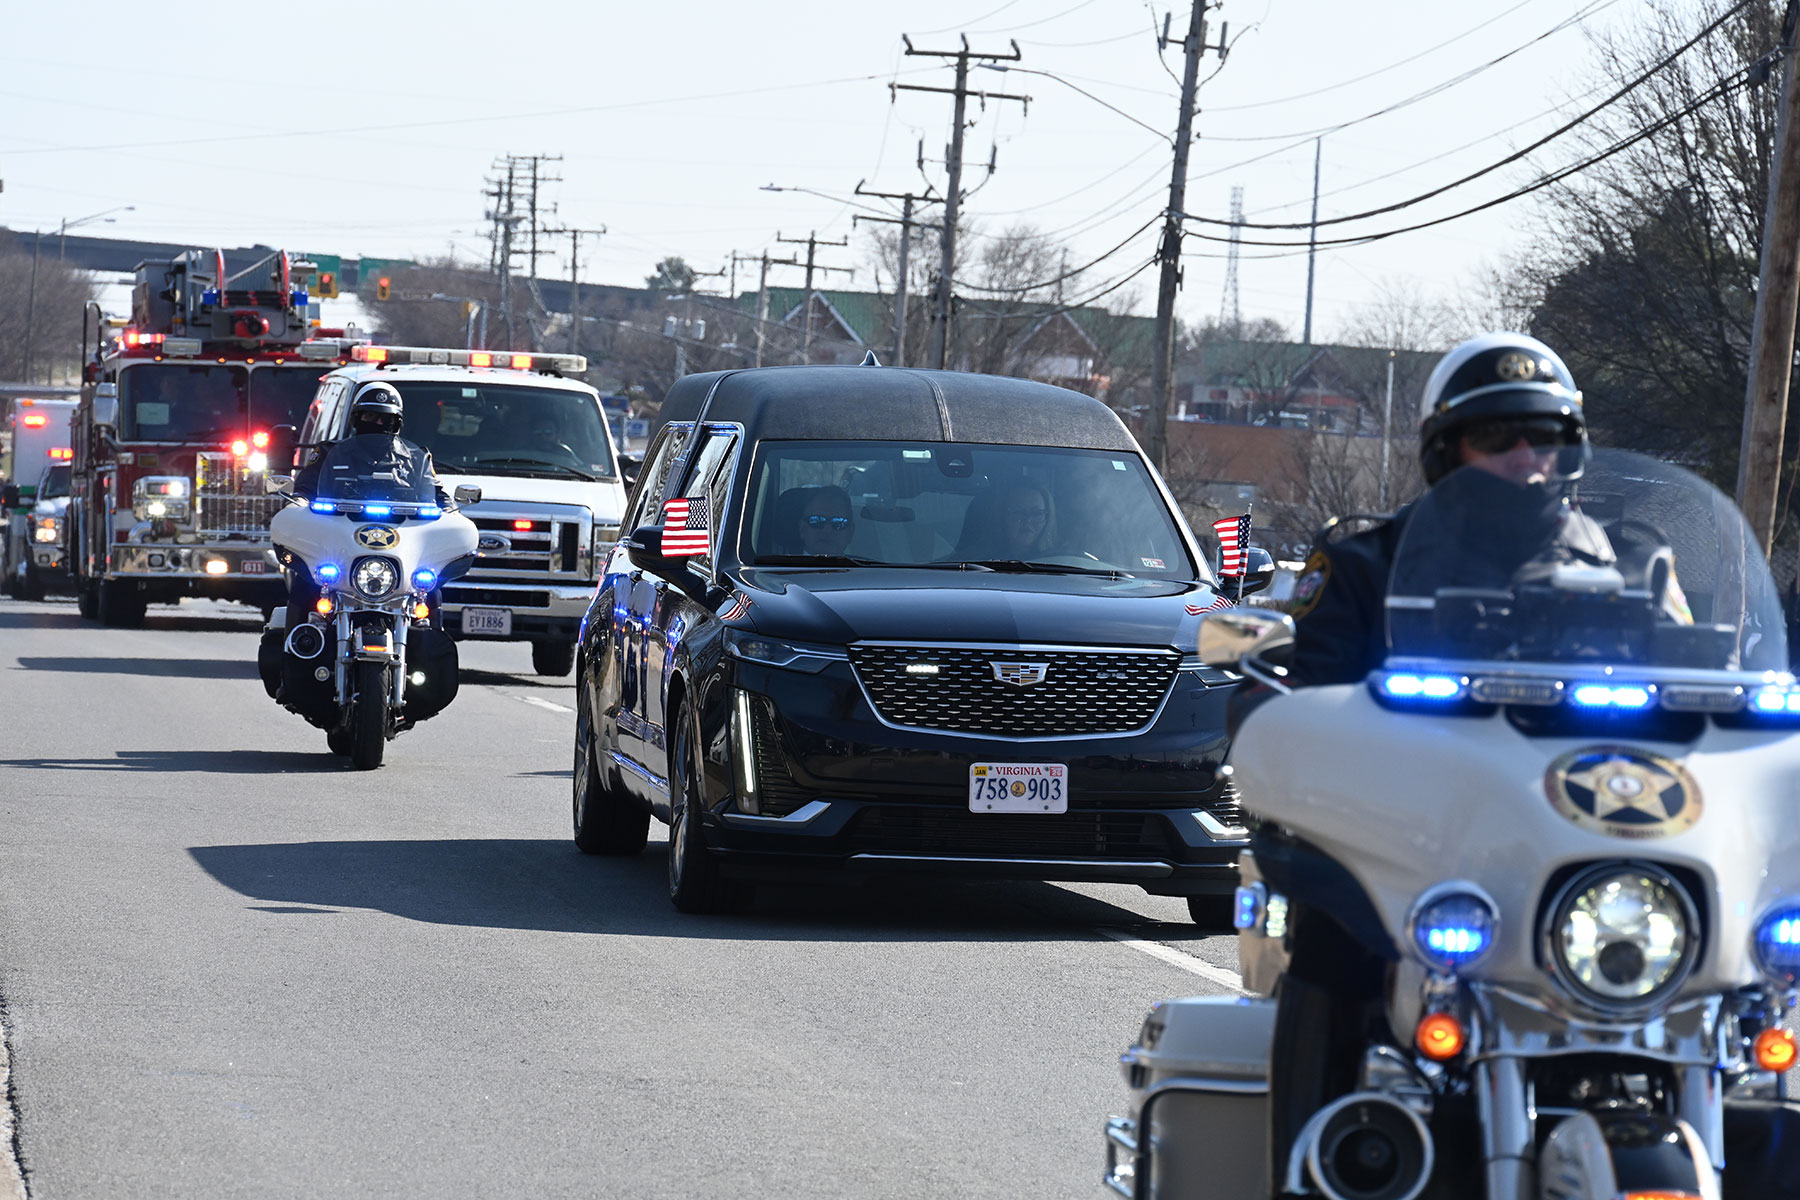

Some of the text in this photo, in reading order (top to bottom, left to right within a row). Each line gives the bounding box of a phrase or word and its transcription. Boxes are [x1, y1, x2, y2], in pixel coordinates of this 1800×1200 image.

[996, 766, 1042, 776] VIRGINIA
[975, 778, 1061, 800] 758 903
